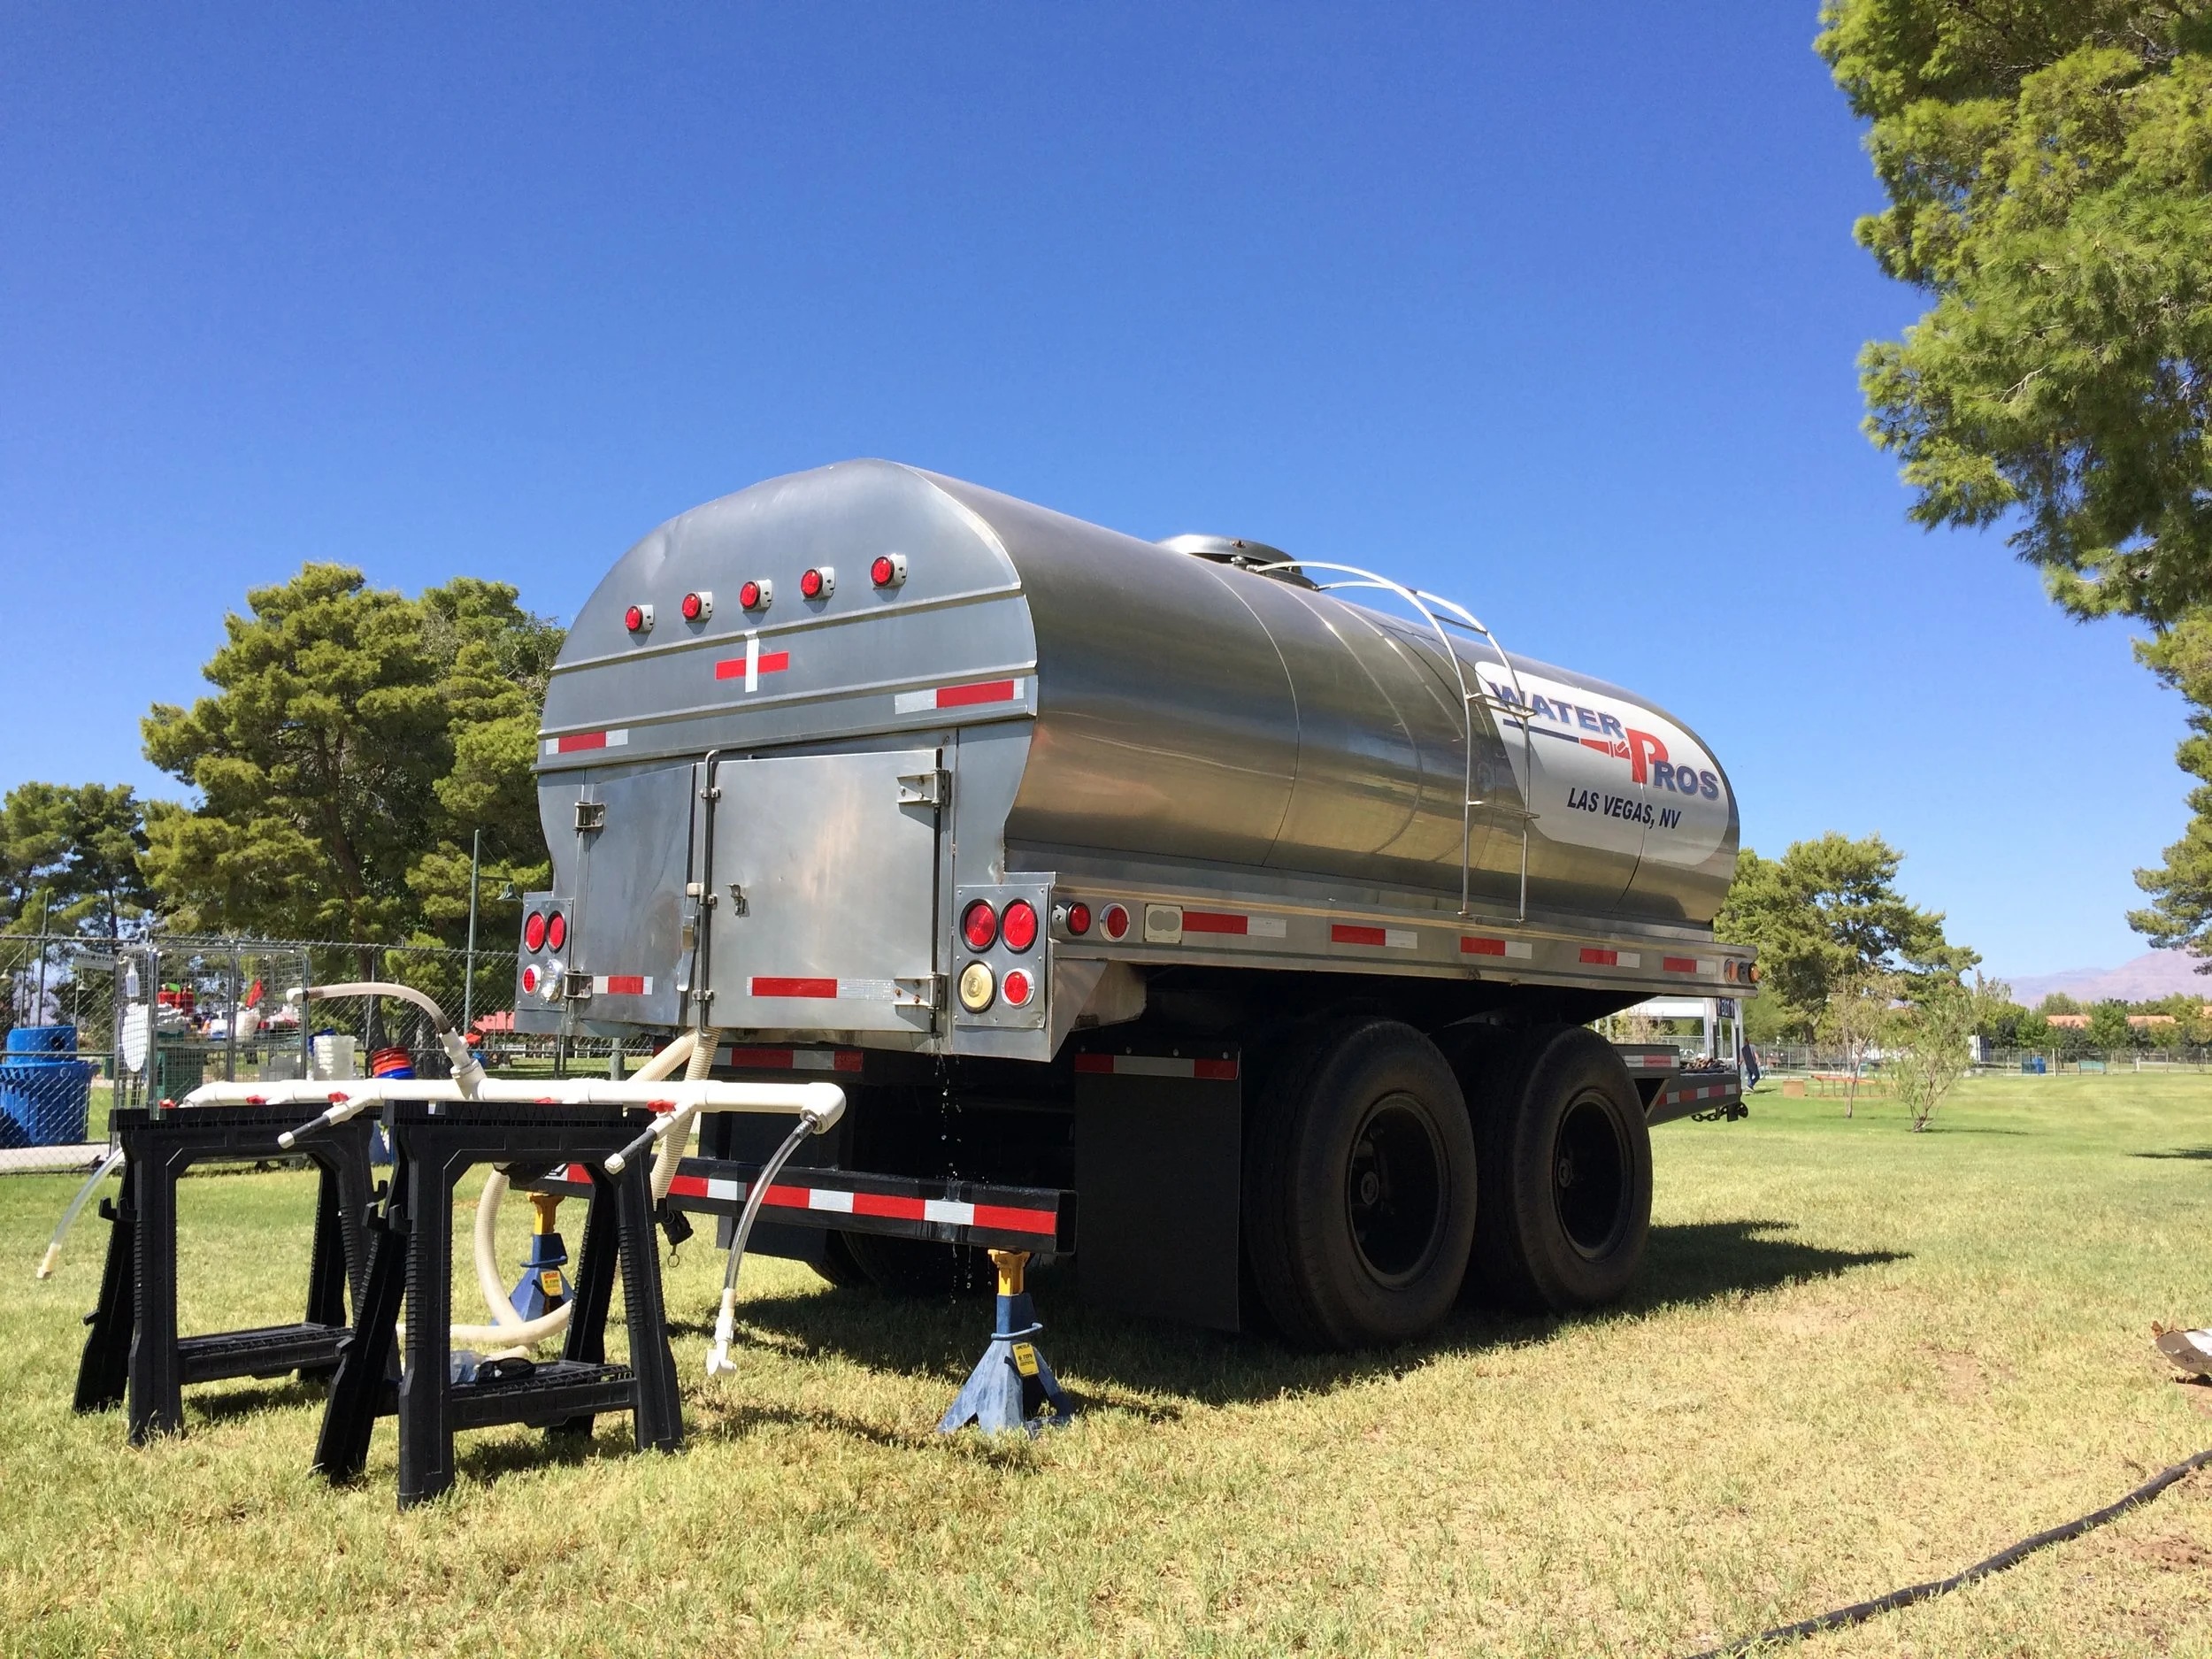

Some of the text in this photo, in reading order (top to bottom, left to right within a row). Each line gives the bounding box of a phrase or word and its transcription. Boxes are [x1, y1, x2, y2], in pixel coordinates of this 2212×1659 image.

[1486, 681, 1719, 801] WATER PROS
[1567, 787, 1682, 830] LAS VEGAS, NV
